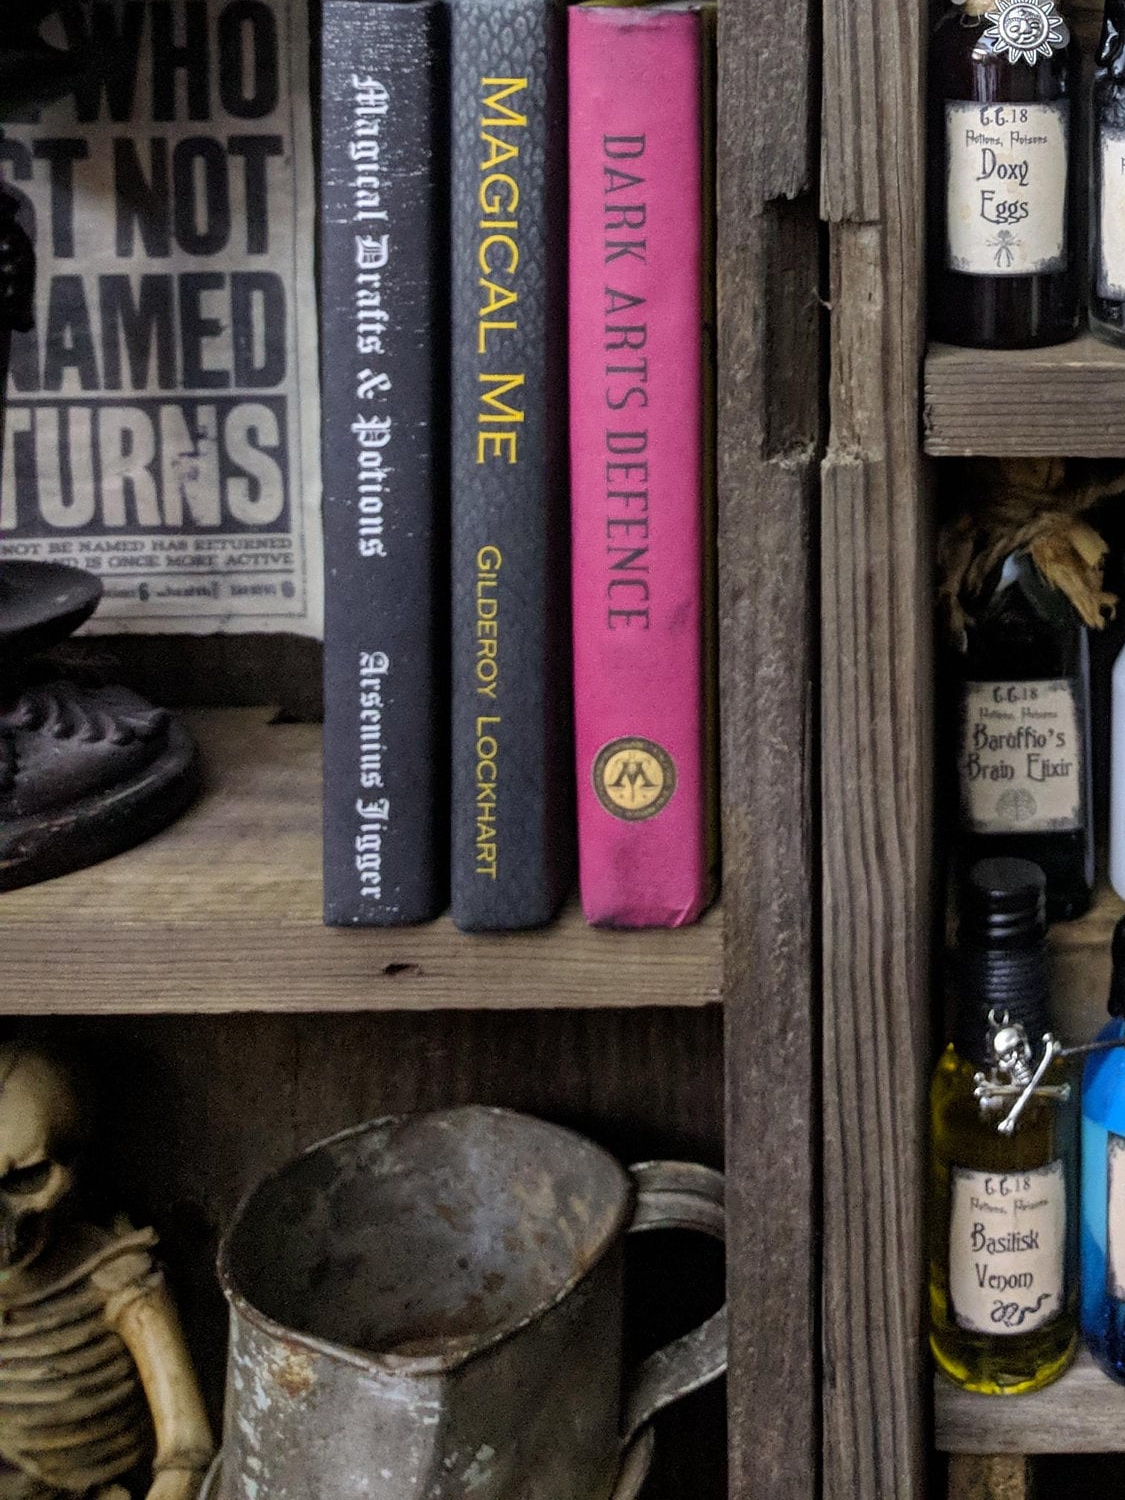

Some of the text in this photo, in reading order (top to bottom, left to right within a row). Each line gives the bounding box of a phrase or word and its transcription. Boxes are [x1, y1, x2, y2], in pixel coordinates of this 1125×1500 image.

[113, 135, 283, 260] NOT
[976, 148, 1029, 186] Doxy
[980, 190, 1029, 225] Eggs
[350, 73, 392, 558] Magical Drafts & Potions
[476, 76, 528, 464] MAGICAL ME
[603, 132, 650, 631] DARK ARTS DEFENCE
[354, 651, 390, 899] Arsenius Jigger
[476, 545, 502, 880] GILDEROY LOCKHART
[967, 753, 1073, 782] Brain Elixir
[971, 1222, 1040, 1254] Basilisk
[976, 1263, 1033, 1291] Venom
